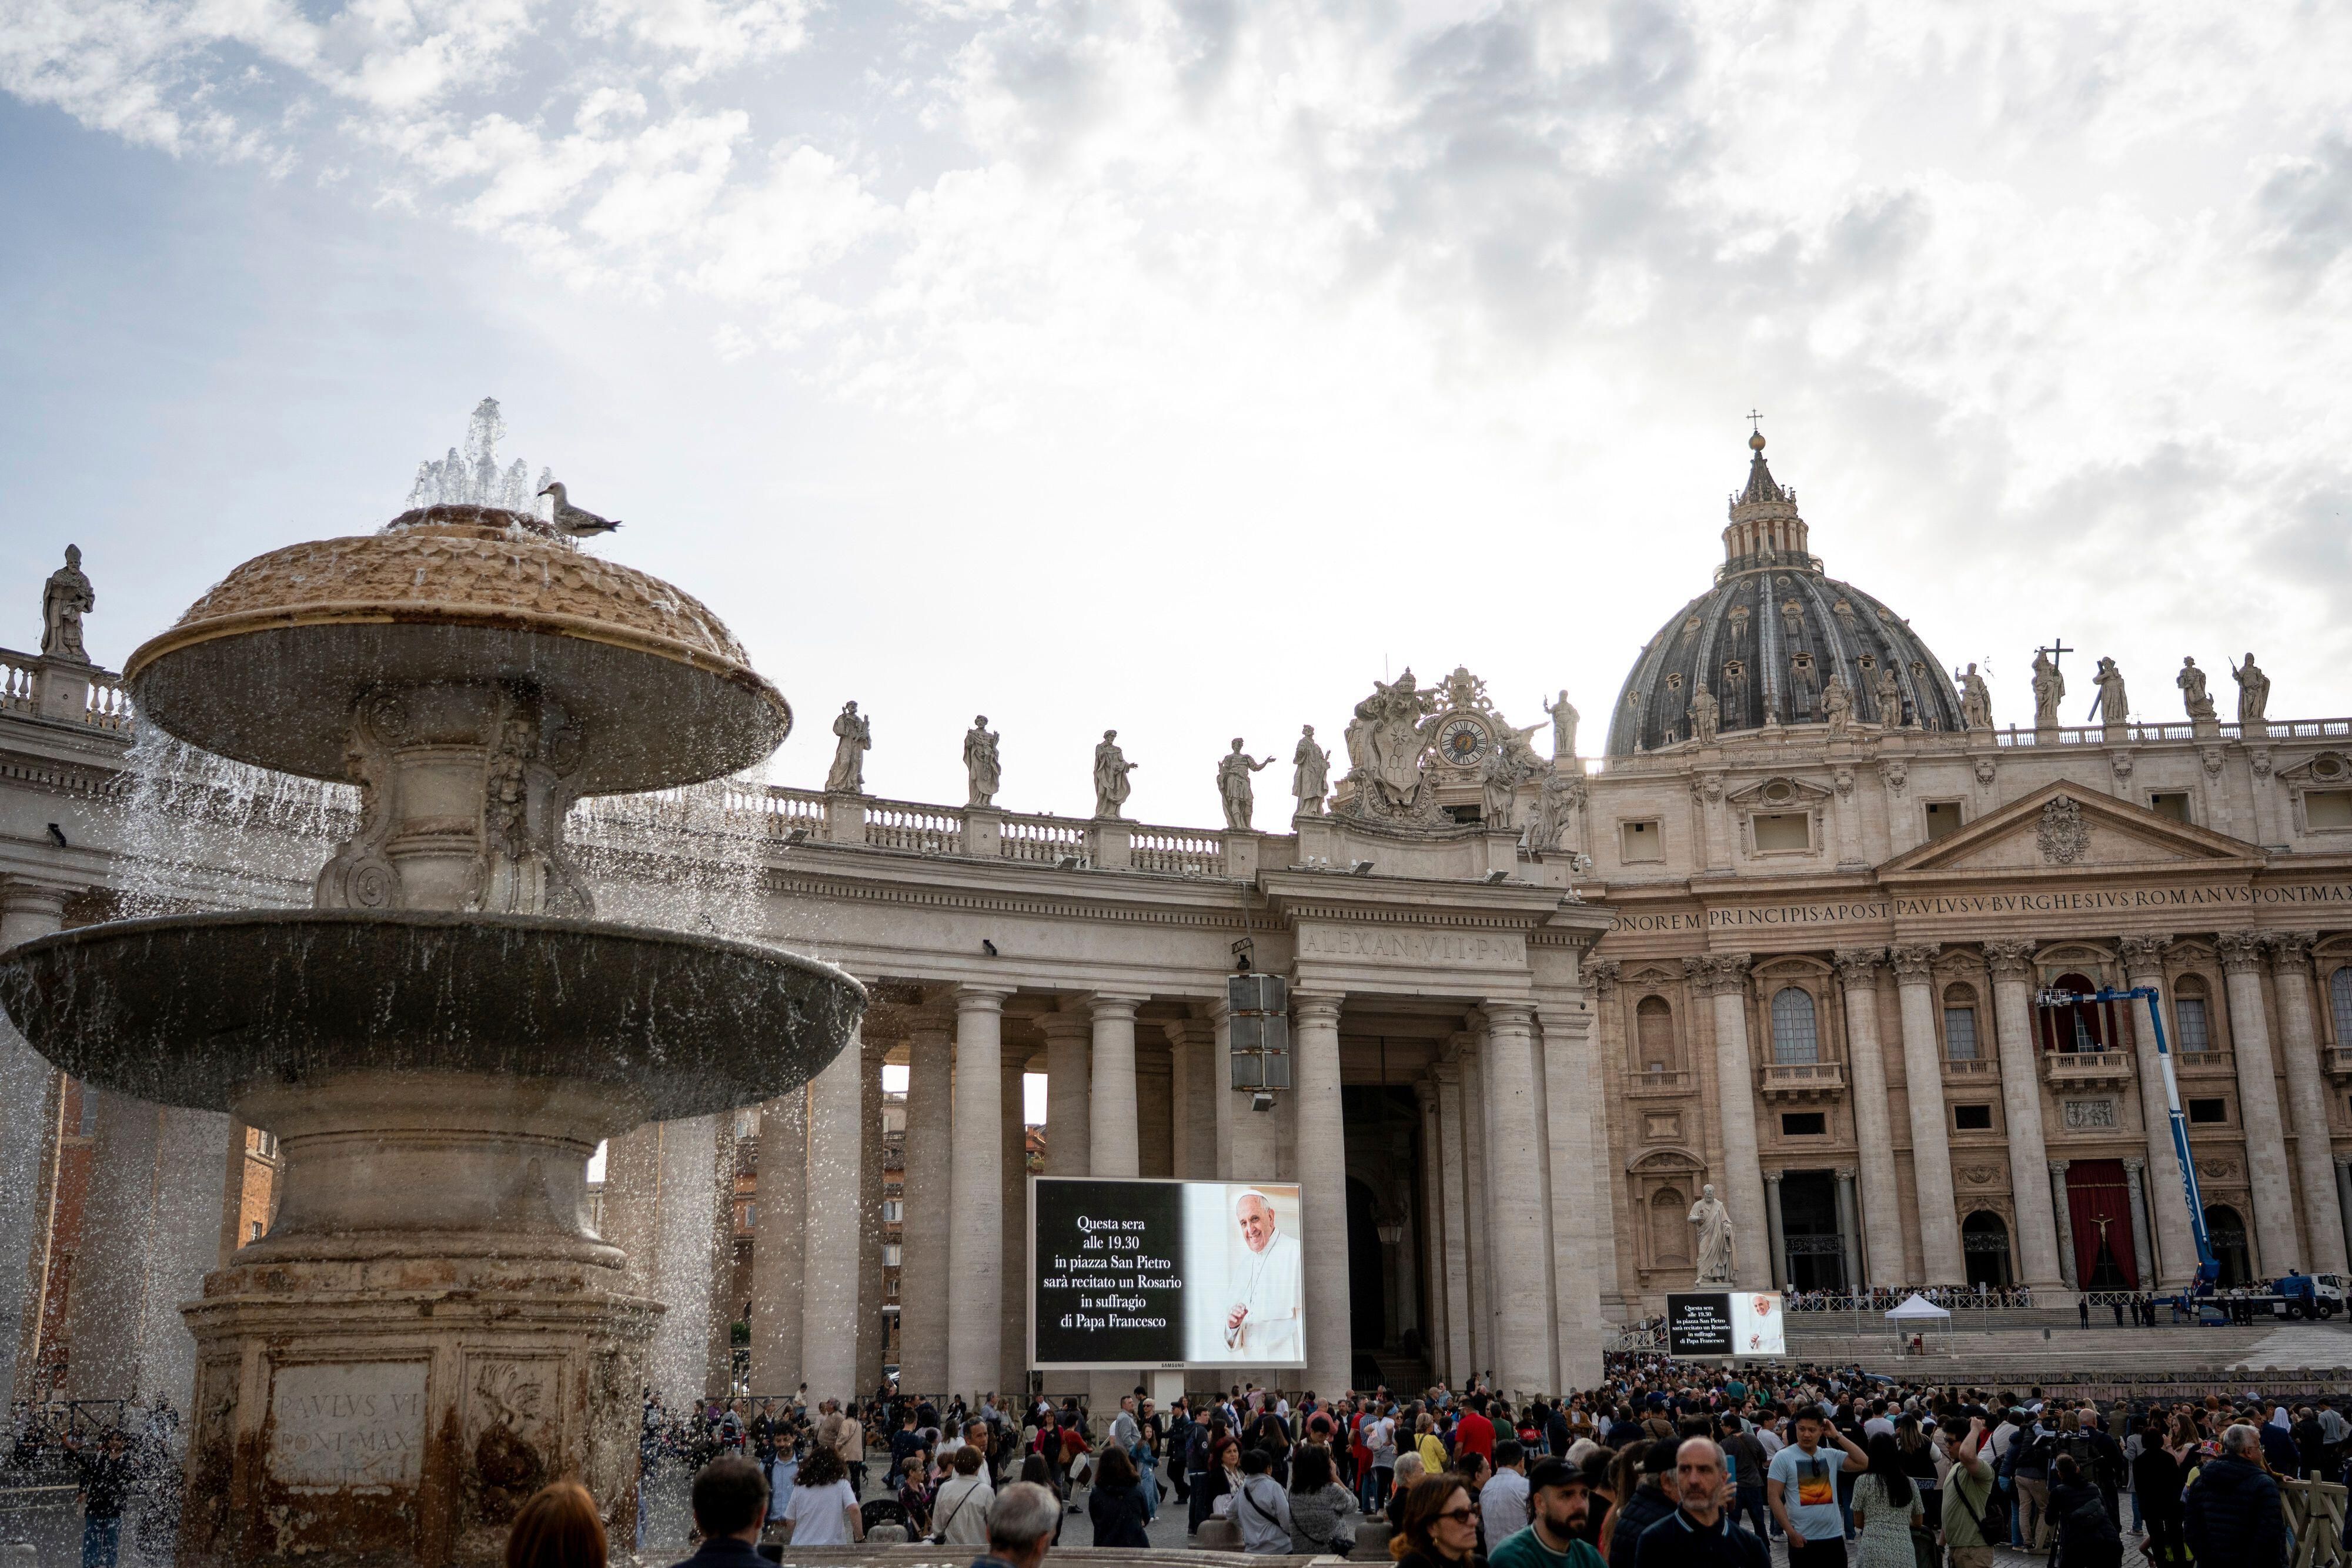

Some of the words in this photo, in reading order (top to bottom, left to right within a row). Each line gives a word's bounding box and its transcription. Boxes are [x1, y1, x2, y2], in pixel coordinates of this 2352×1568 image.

[1709, 907, 1819, 925] PRINCIPIS
[1823, 903, 1889, 921] APOST
[1896, 898, 1969, 914] PAVLVS
[1972, 897, 1985, 911] V
[1992, 892, 2129, 911] BVRGHESIVS
[2135, 887, 2250, 906] ROMANVS
[2250, 887, 2308, 904] PONT
[1304, 930, 1409, 956] ALEXAN
[1421, 936, 1466, 959] VII
[1476, 938, 1489, 959] P
[1502, 940, 1524, 961] M
[1077, 1215, 1119, 1233] Questa
[1122, 1221, 1145, 1230] sera
[1083, 1235, 1104, 1249] alle
[1108, 1235, 1140, 1249] 19.30
[1055, 1254, 1067, 1268] in
[1070, 1254, 1108, 1272] piazza
[1111, 1255, 1134, 1269] San
[1137, 1255, 1171, 1269] Pietro
[1044, 1274, 1068, 1288] sarà
[1071, 1275, 1115, 1288] recitato
[1119, 1279, 1134, 1288] un
[1137, 1274, 1182, 1289] Rosario
[1081, 1293, 1093, 1308] in
[1096, 1293, 1146, 1311] suffragio
[1061, 1313, 1073, 1328] di
[1076, 1313, 1105, 1332] Papa
[1108, 1313, 1166, 1328] Francesco
[279, 1394, 376, 1418] PAVLVS
[390, 1393, 418, 1416] VI
[279, 1432, 348, 1452] PONT
[357, 1430, 411, 1451] MAX
